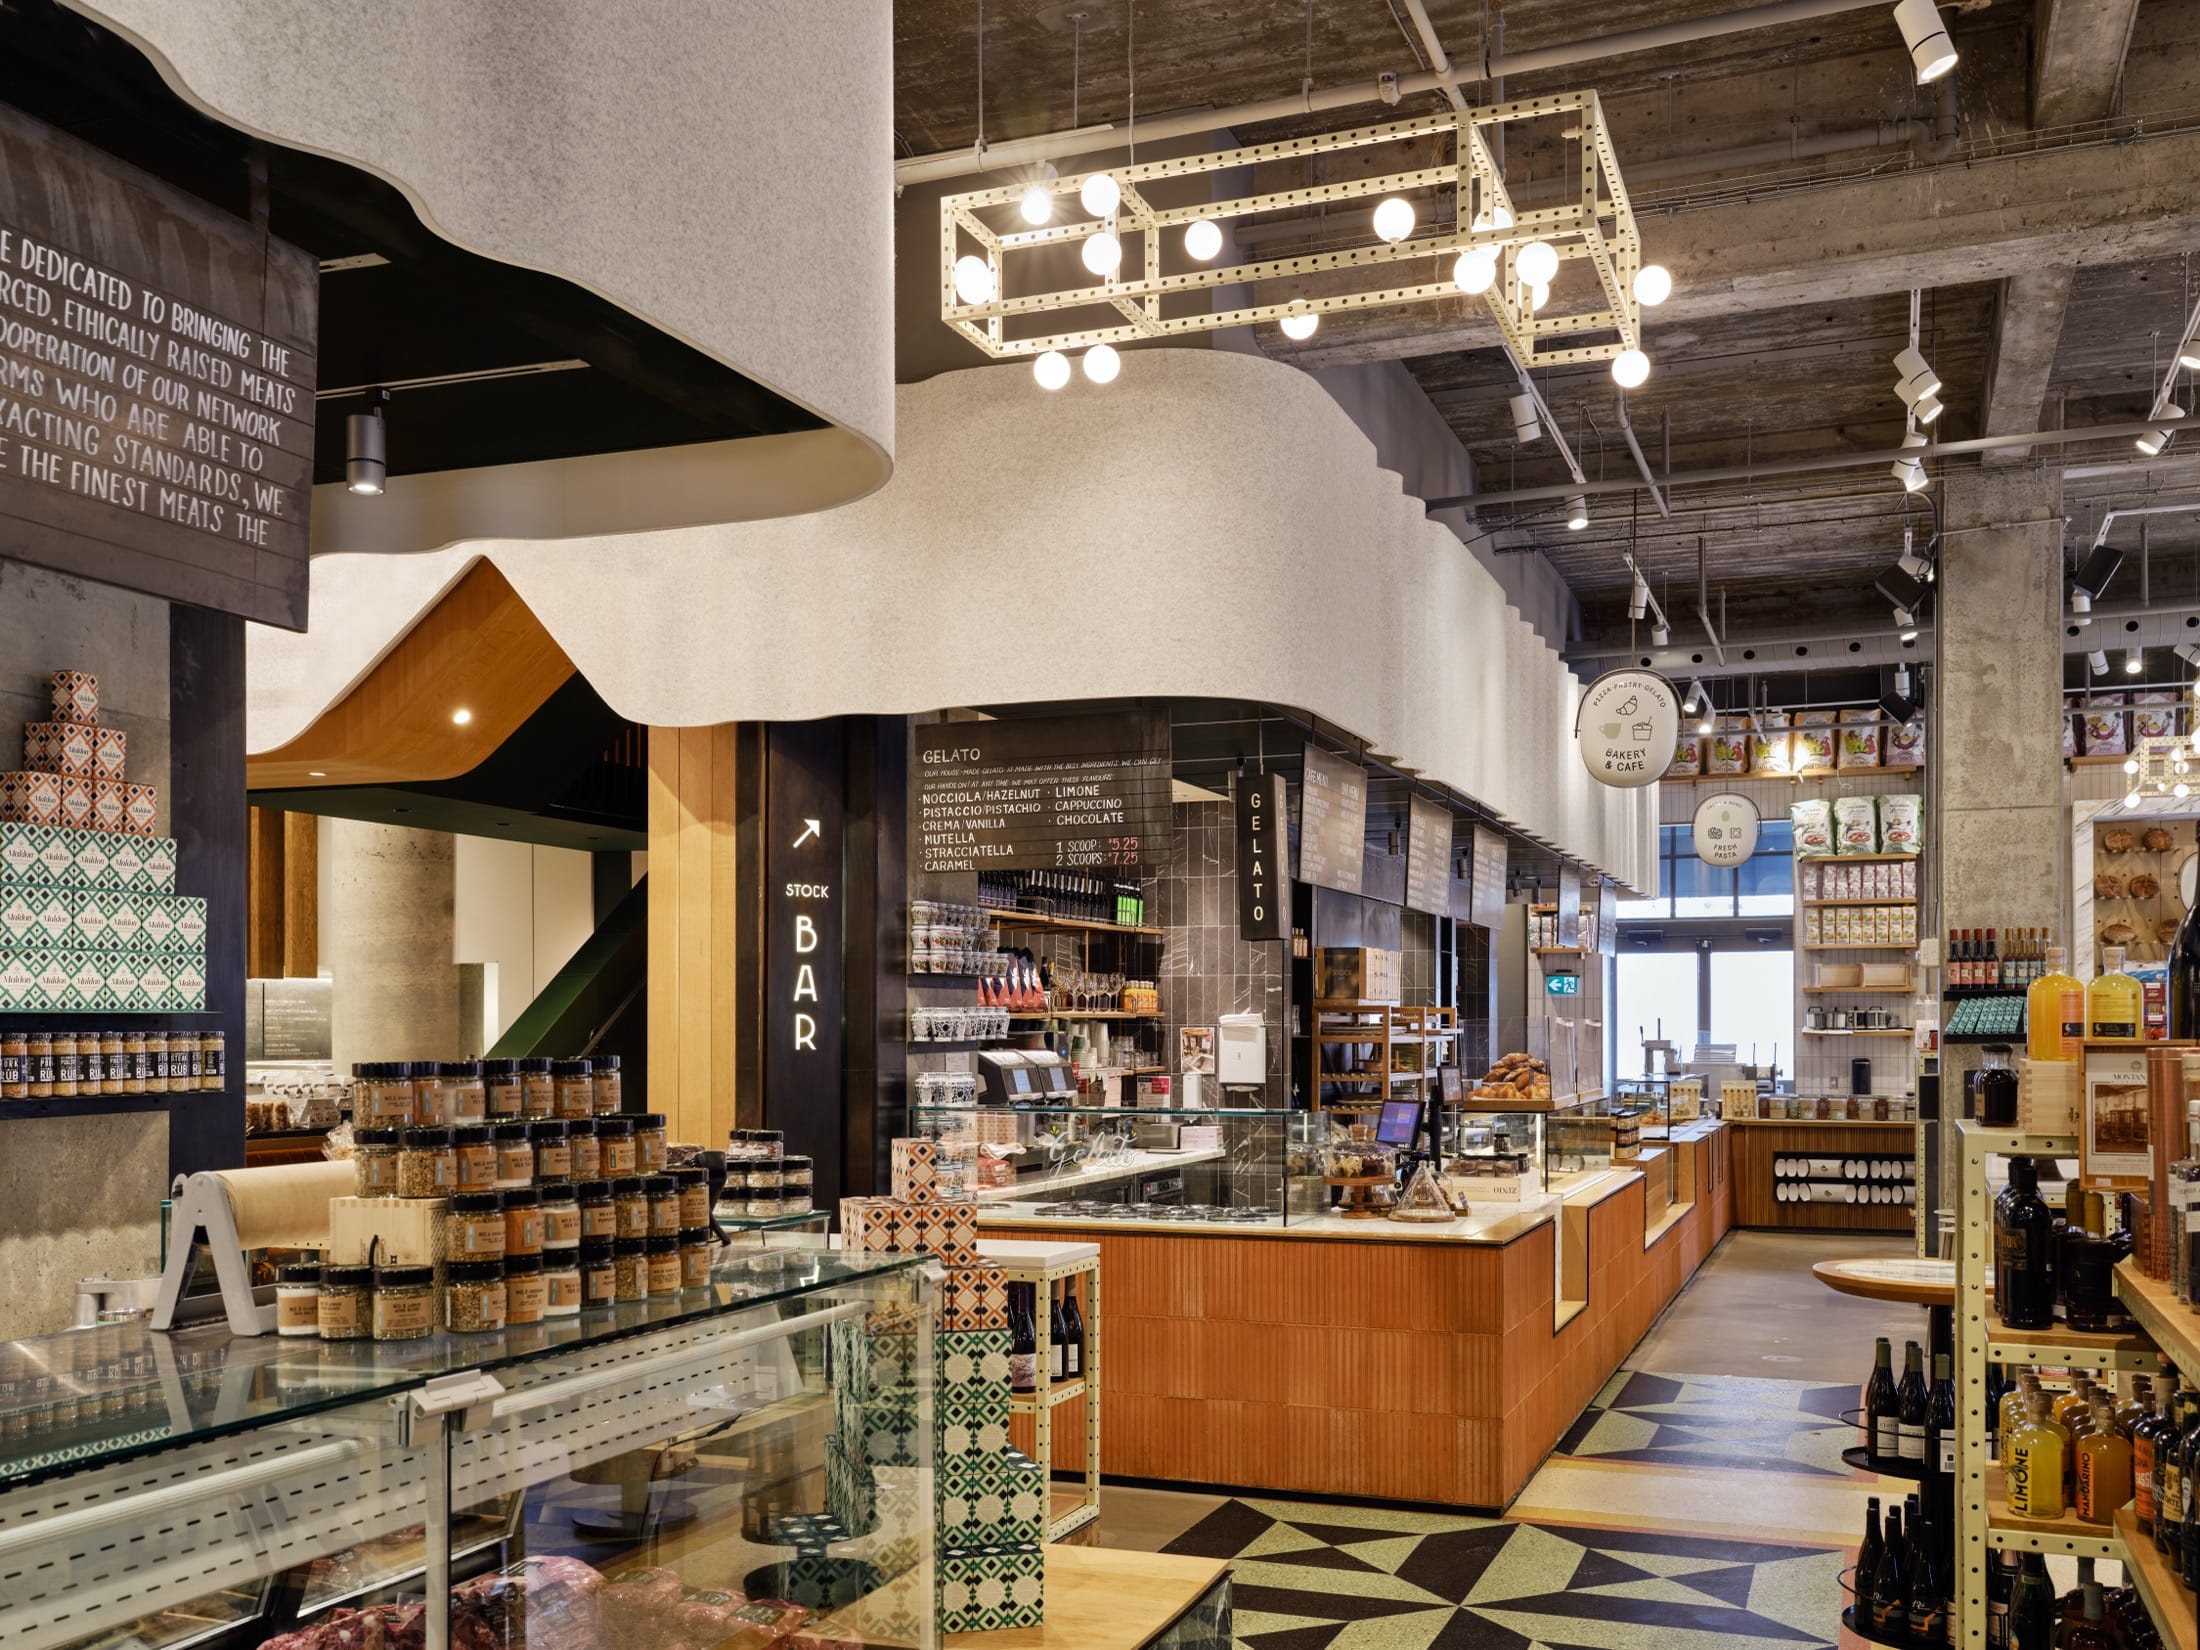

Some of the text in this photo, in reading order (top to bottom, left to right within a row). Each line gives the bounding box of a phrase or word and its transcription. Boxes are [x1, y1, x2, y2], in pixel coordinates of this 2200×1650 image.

[21, 238, 132, 311] DEDICATED
[142, 290, 166, 324] TO
[171, 302, 251, 359] BRINGING
[260, 340, 291, 378] THE
[64, 298, 160, 362] ETHICALLY
[167, 340, 233, 389] RAISED
[240, 369, 296, 414] MEATS
[122, 364, 150, 396] OF
[152, 375, 189, 412] OUR
[197, 391, 282, 447] NETWORK
[56, 378, 117, 423] WHO
[127, 403, 170, 441] ARE
[182, 422, 232, 464] ABLE
[240, 441, 263, 472] TO
[113, 434, 249, 511] STANDARDS,
[254, 481, 285, 516] WE
[20, 445, 63, 484] THE
[71, 461, 149, 513] FINEST
[159, 487, 224, 533] MEATS
[236, 512, 270, 546] THE
[1644, 684, 1666, 707] GELATO
[923, 748, 981, 764] GELATO
[1605, 748, 1647, 760] BAKERY
[1605, 761, 1644, 771] & CAFE
[922, 788, 1041, 805] NOCCIOLA/HAZELNUT
[1055, 785, 1100, 798] LIMONE
[923, 802, 1041, 819] PISTACCIO/PISTACHIO
[1055, 798, 1122, 812] CAPPUCCINO
[922, 818, 1006, 832] CREMA/VANILLA
[1056, 812, 1125, 826] CHOCOLATE
[924, 832, 975, 845] NUTELLA
[925, 844, 1014, 859] STRACCIATELLA
[1056, 842, 1063, 853] 1
[1714, 844, 1737, 852] FRESH
[8, 849, 172, 872] Maldon Maldon Maldon Maldon Maldon
[1056, 855, 1063, 866] 2
[1251, 793, 1264, 921] GELATO
[924, 860, 976, 871] CARAMEL
[785, 883, 829, 898] STOCK
[6, 913, 203, 930] Maldon Maldon Maldon Maldon Maldon Maldon
[3, 976, 201, 988] Maldon Maldon Maldon Maldon Maldon Maldon
[793, 915, 818, 1050] BAR
[2113, 1073, 2146, 1081] MONTAN
[2015, 1447, 2029, 1512] LIMONE
[2082, 1451, 2092, 1517] MANDARINO
